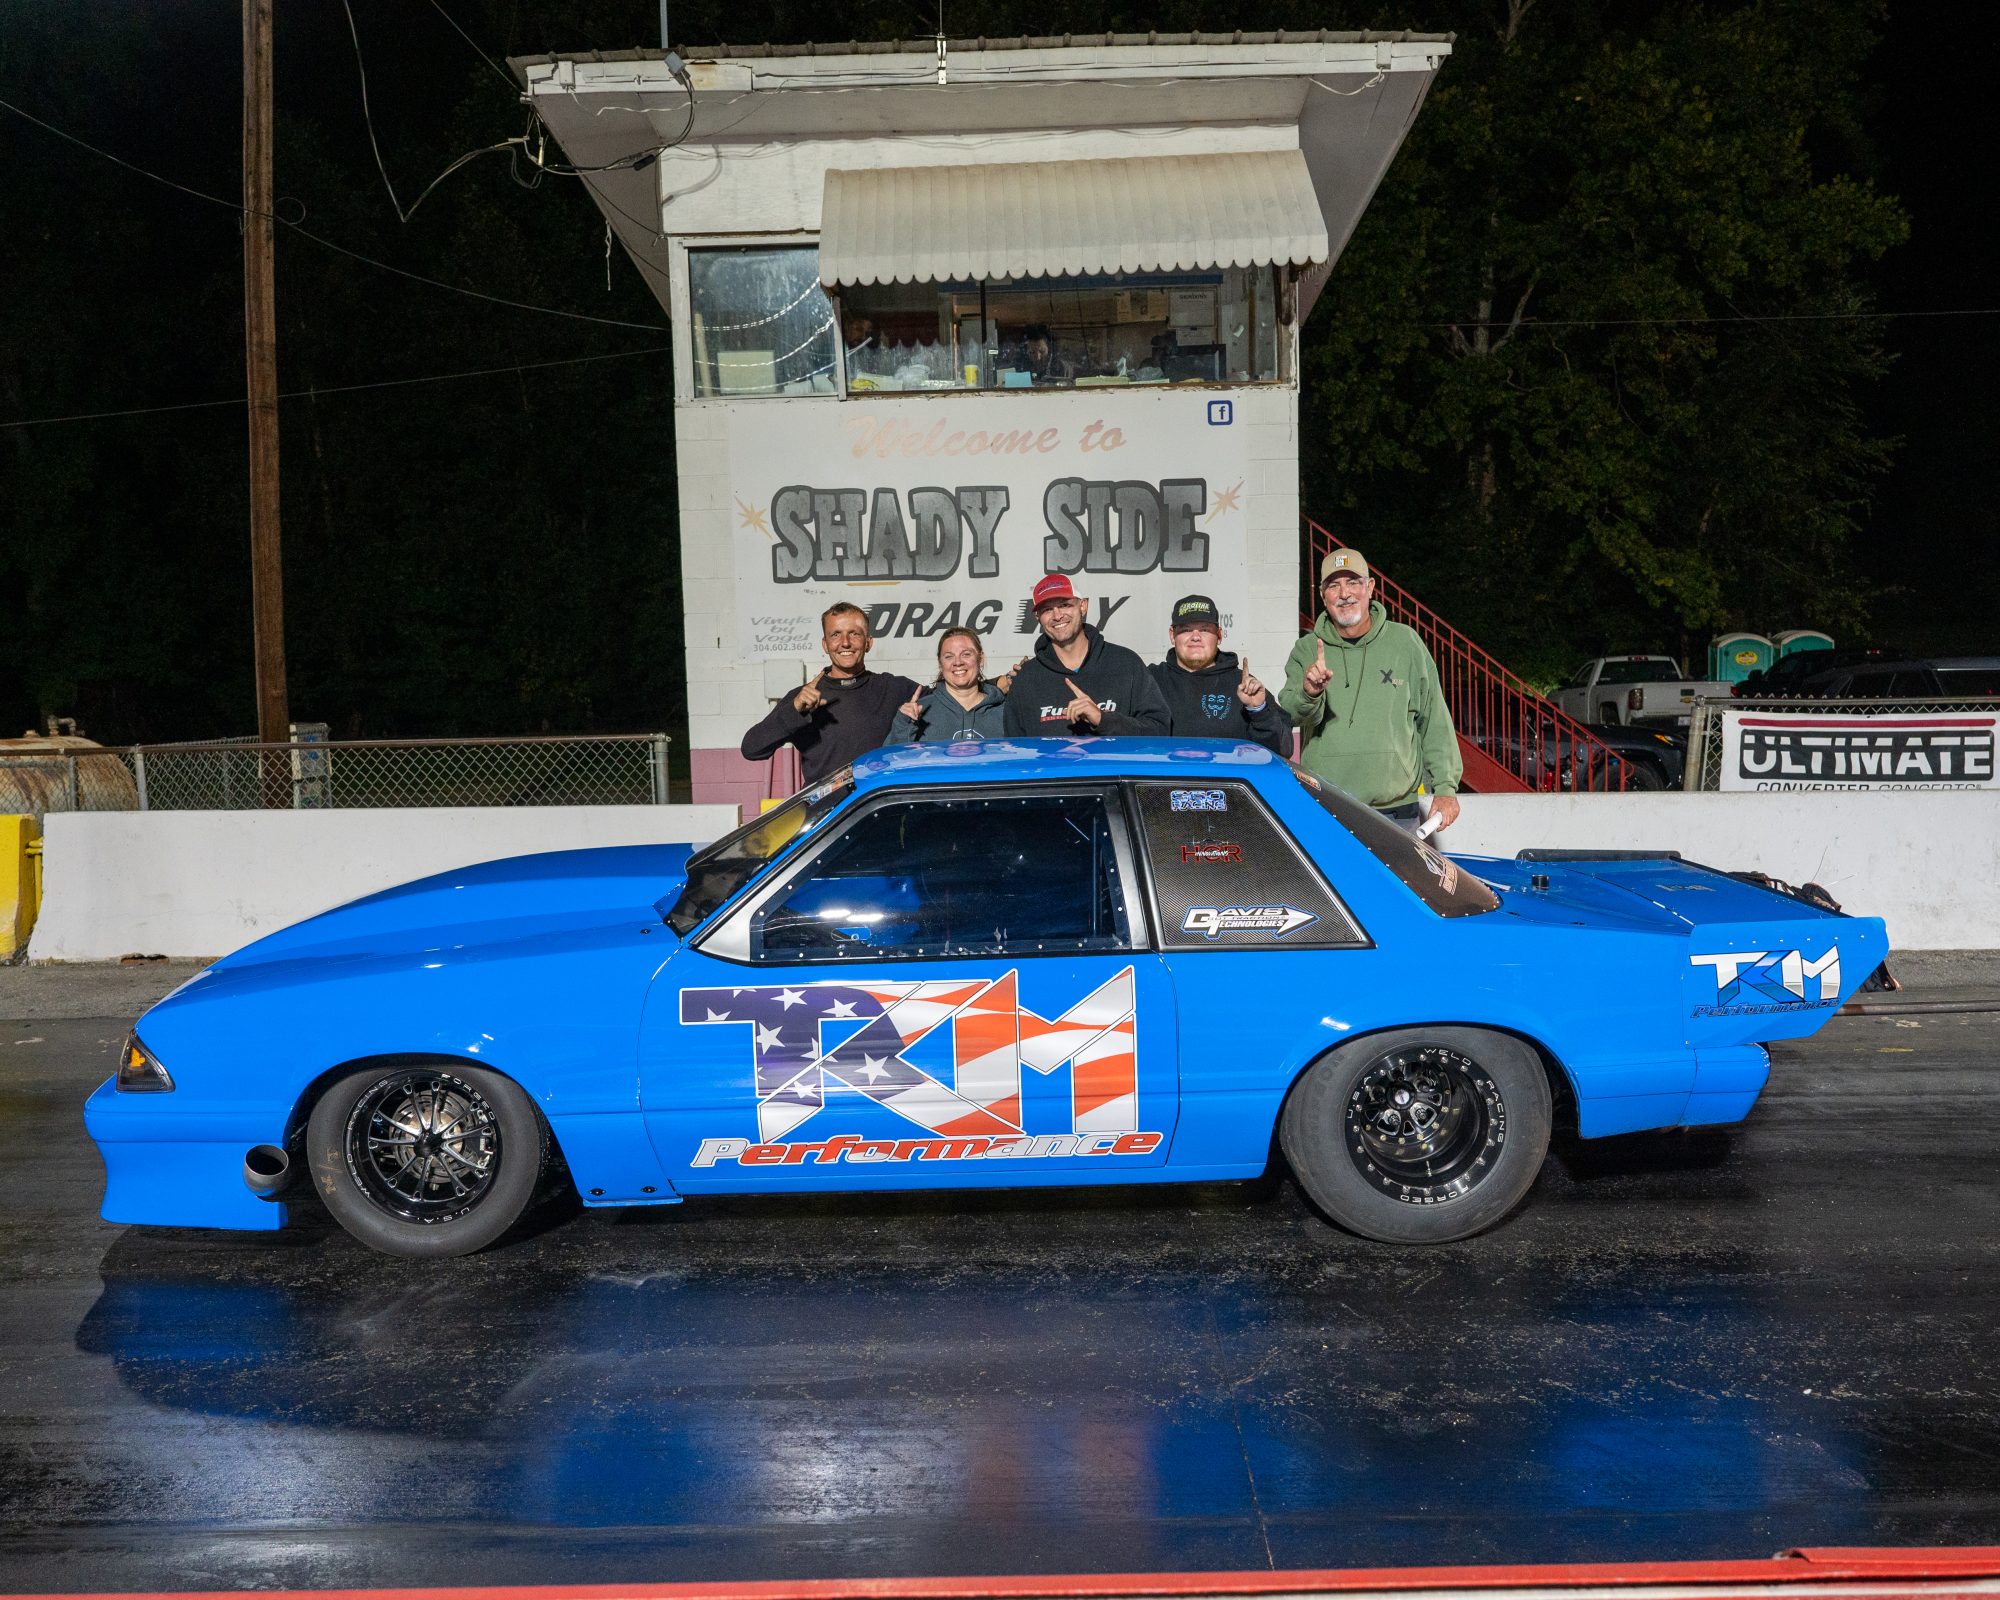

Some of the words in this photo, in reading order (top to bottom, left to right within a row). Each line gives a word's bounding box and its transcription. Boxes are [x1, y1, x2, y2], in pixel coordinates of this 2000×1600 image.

[847, 416, 1060, 459] Welcome
[1078, 419, 1127, 452] to
[771, 485, 1010, 584] SHADY
[1044, 476, 1210, 575] SIDE
[755, 633, 811, 643] Vogel
[770, 625, 795, 634] by
[865, 599, 1003, 638] DRAG
[753, 643, 813, 652] 304.602.3662
[1743, 734, 1991, 775] ULTIMATE
[1690, 999, 1841, 1018] Performance
[347, 1080, 388, 1130] RACING
[441, 1074, 496, 1121] FORGED
[1424, 1048, 1472, 1066] WELD
[1485, 1079, 1505, 1143] RACING
[691, 1131, 1164, 1167] Performance
[347, 1153, 370, 1198] WELD
[1400, 1184, 1469, 1204] FORGED
